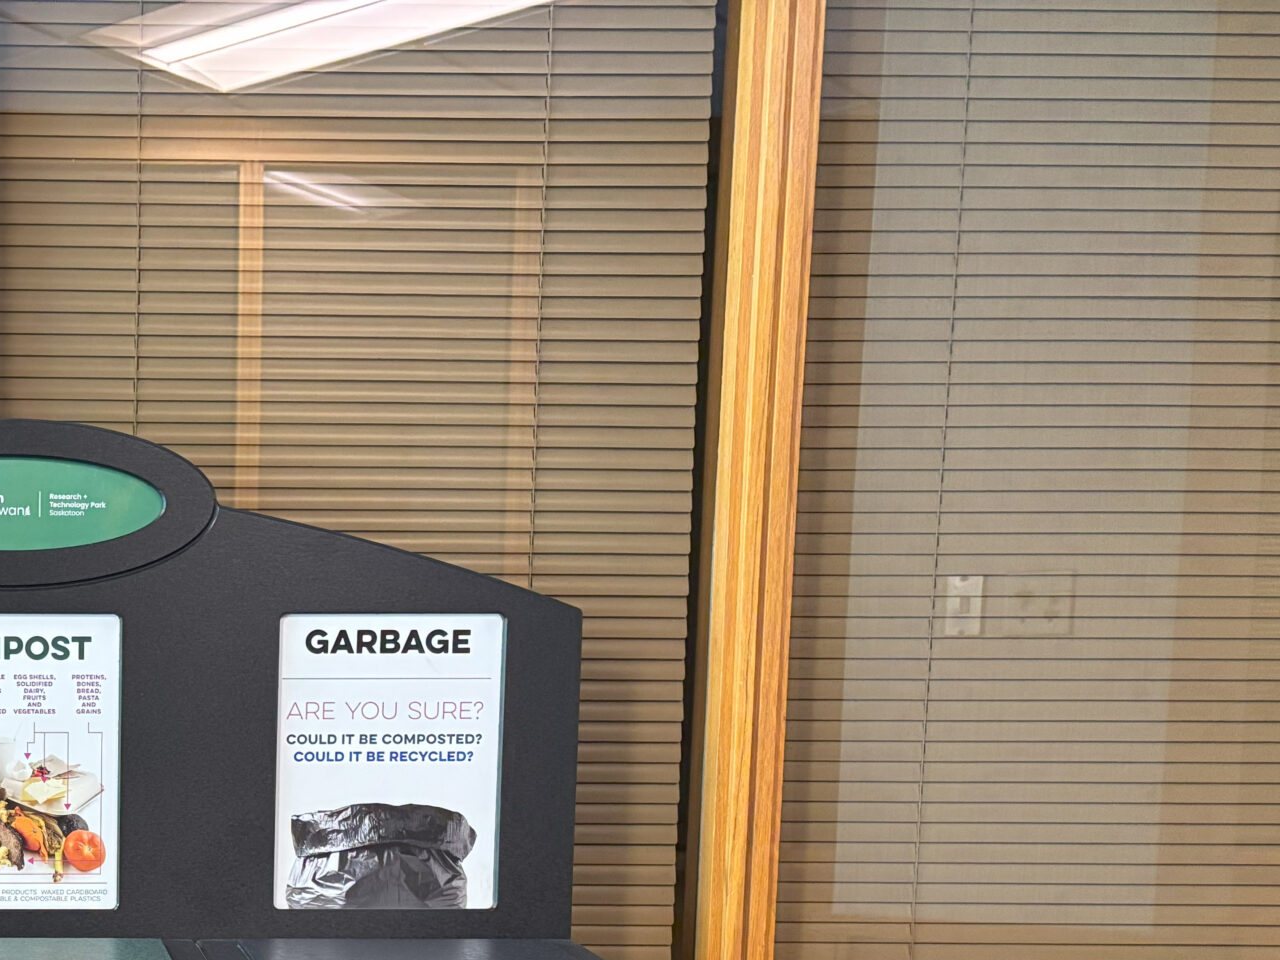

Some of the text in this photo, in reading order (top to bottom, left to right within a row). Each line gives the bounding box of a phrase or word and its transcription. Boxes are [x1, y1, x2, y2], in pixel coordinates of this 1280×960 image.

[49, 501, 89, 510] Technology
[305, 629, 471, 654] GARBAGE
[286, 701, 484, 720] ARE YOU SURE?
[286, 734, 483, 745] COULD IT BE COMPOSTED?
[293, 751, 474, 762] COULD IT BE RECYCLED?
